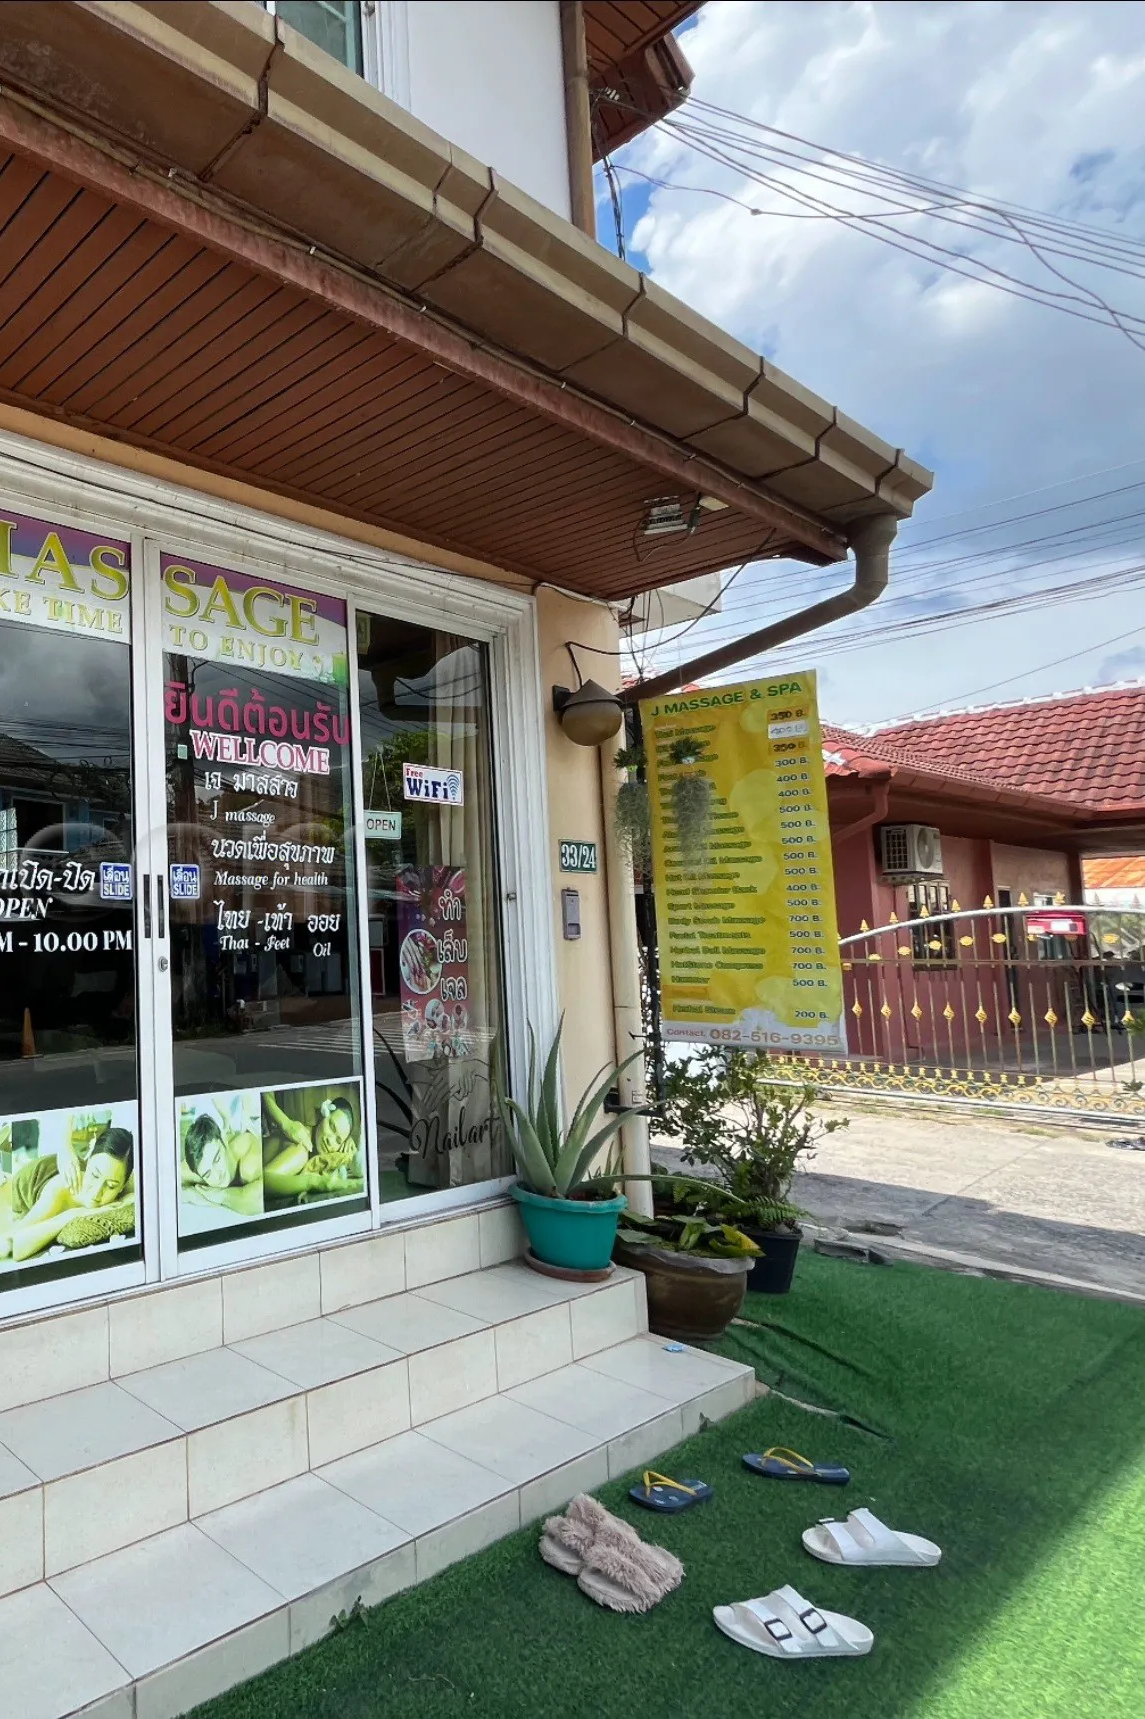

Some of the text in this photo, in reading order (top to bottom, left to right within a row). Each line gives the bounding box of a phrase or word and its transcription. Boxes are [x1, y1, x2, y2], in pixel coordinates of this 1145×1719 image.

[43, 596, 123, 634] TIME
[170, 624, 208, 651] TO
[220, 637, 304, 671] ENJOY
[651, 682, 802, 717] J MASSAGE & SPA
[164, 681, 351, 745] ยินดีต้อนรับ
[189, 729, 330, 775] WELLCOME
[774, 758, 796, 767] 300
[204, 771, 221, 790] เจ
[405, 767, 424, 778] Free
[776, 774, 797, 782] 400
[406, 777, 449, 799] WiFi
[778, 789, 799, 797] 400
[210, 799, 275, 827] J massage
[779, 805, 800, 813] 500
[366, 819, 396, 831] OPEN
[780, 820, 802, 829] 500
[782, 836, 803, 845] 500
[211, 830, 336, 870] นวดเพื่อสุขภาพ
[561, 844, 596, 869] 33/24
[783, 852, 804, 860] 500
[784, 867, 805, 875] 500
[214, 870, 329, 890] Massage for health
[103, 883, 130, 896] SLIDE
[173, 884, 198, 896] SLIDE
[438, 888, 461, 921] ทำ
[787, 899, 808, 907] 500
[212, 900, 252, 931] ไทย
[307, 913, 341, 933] ออย
[34, 932, 99, 953] 10.00
[103, 929, 133, 951] PM
[789, 930, 810, 938] 500
[219, 934, 249, 951] Thai
[264, 934, 290, 951] Feet
[313, 942, 331, 957] Oil
[437, 929, 468, 963] เล็บ
[440, 976, 468, 1001] เจล
[792, 979, 814, 987] 500
[794, 1011, 816, 1019] 200
[709, 1029, 839, 1046] 082-516-9395
